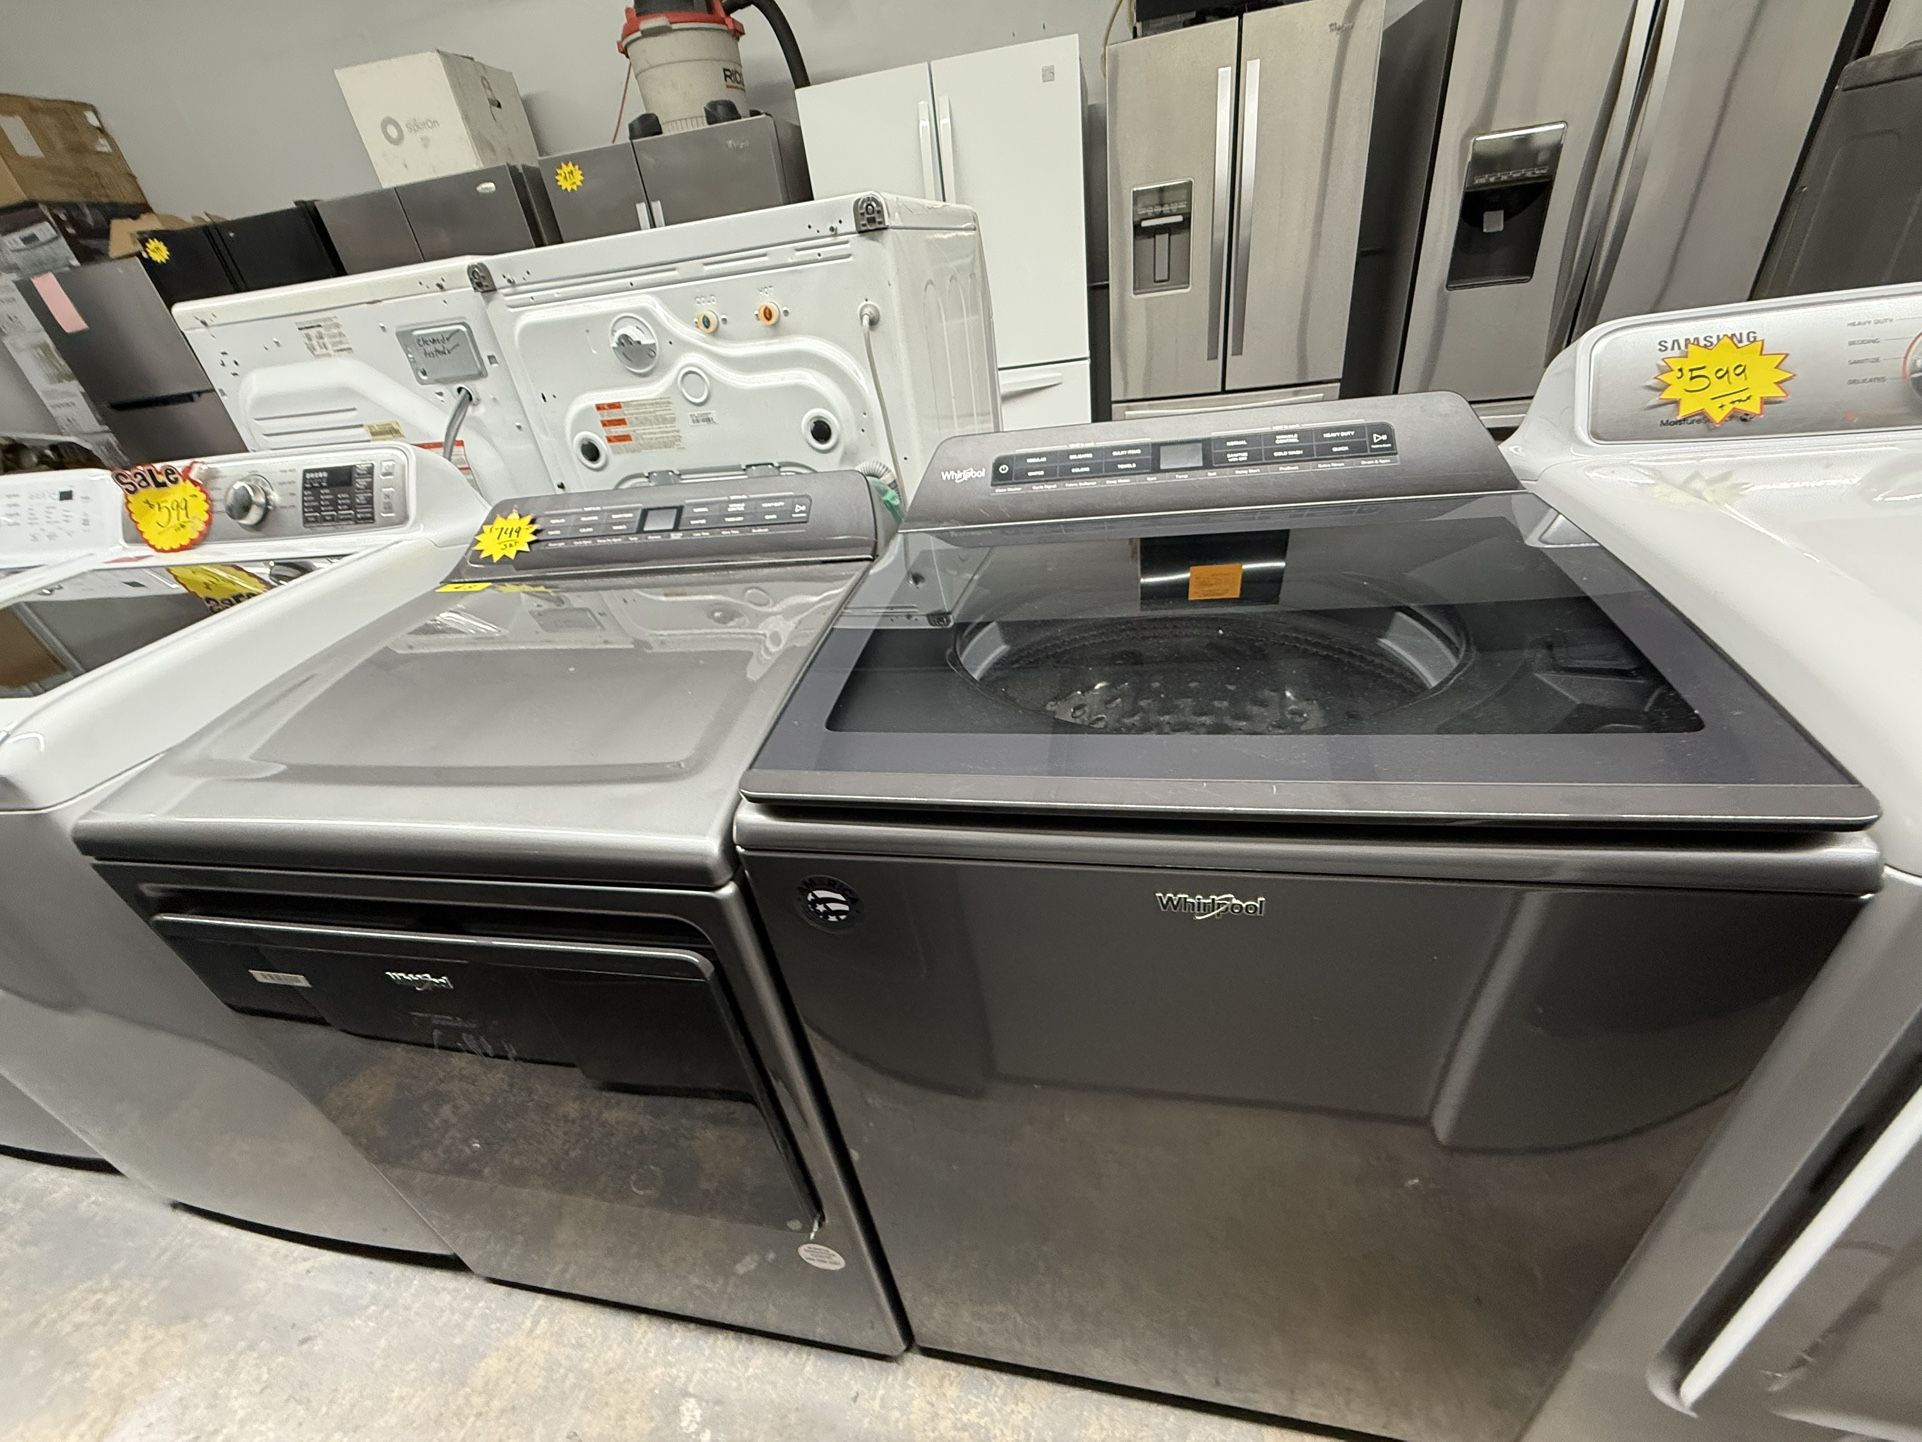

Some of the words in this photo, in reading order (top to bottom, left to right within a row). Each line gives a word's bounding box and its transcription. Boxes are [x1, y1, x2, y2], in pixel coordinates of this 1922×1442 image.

[1657, 331, 1758, 353] SAMSNG
[941, 467, 986, 483] Whirlpool
[1155, 893, 1266, 920] Whirlpool
